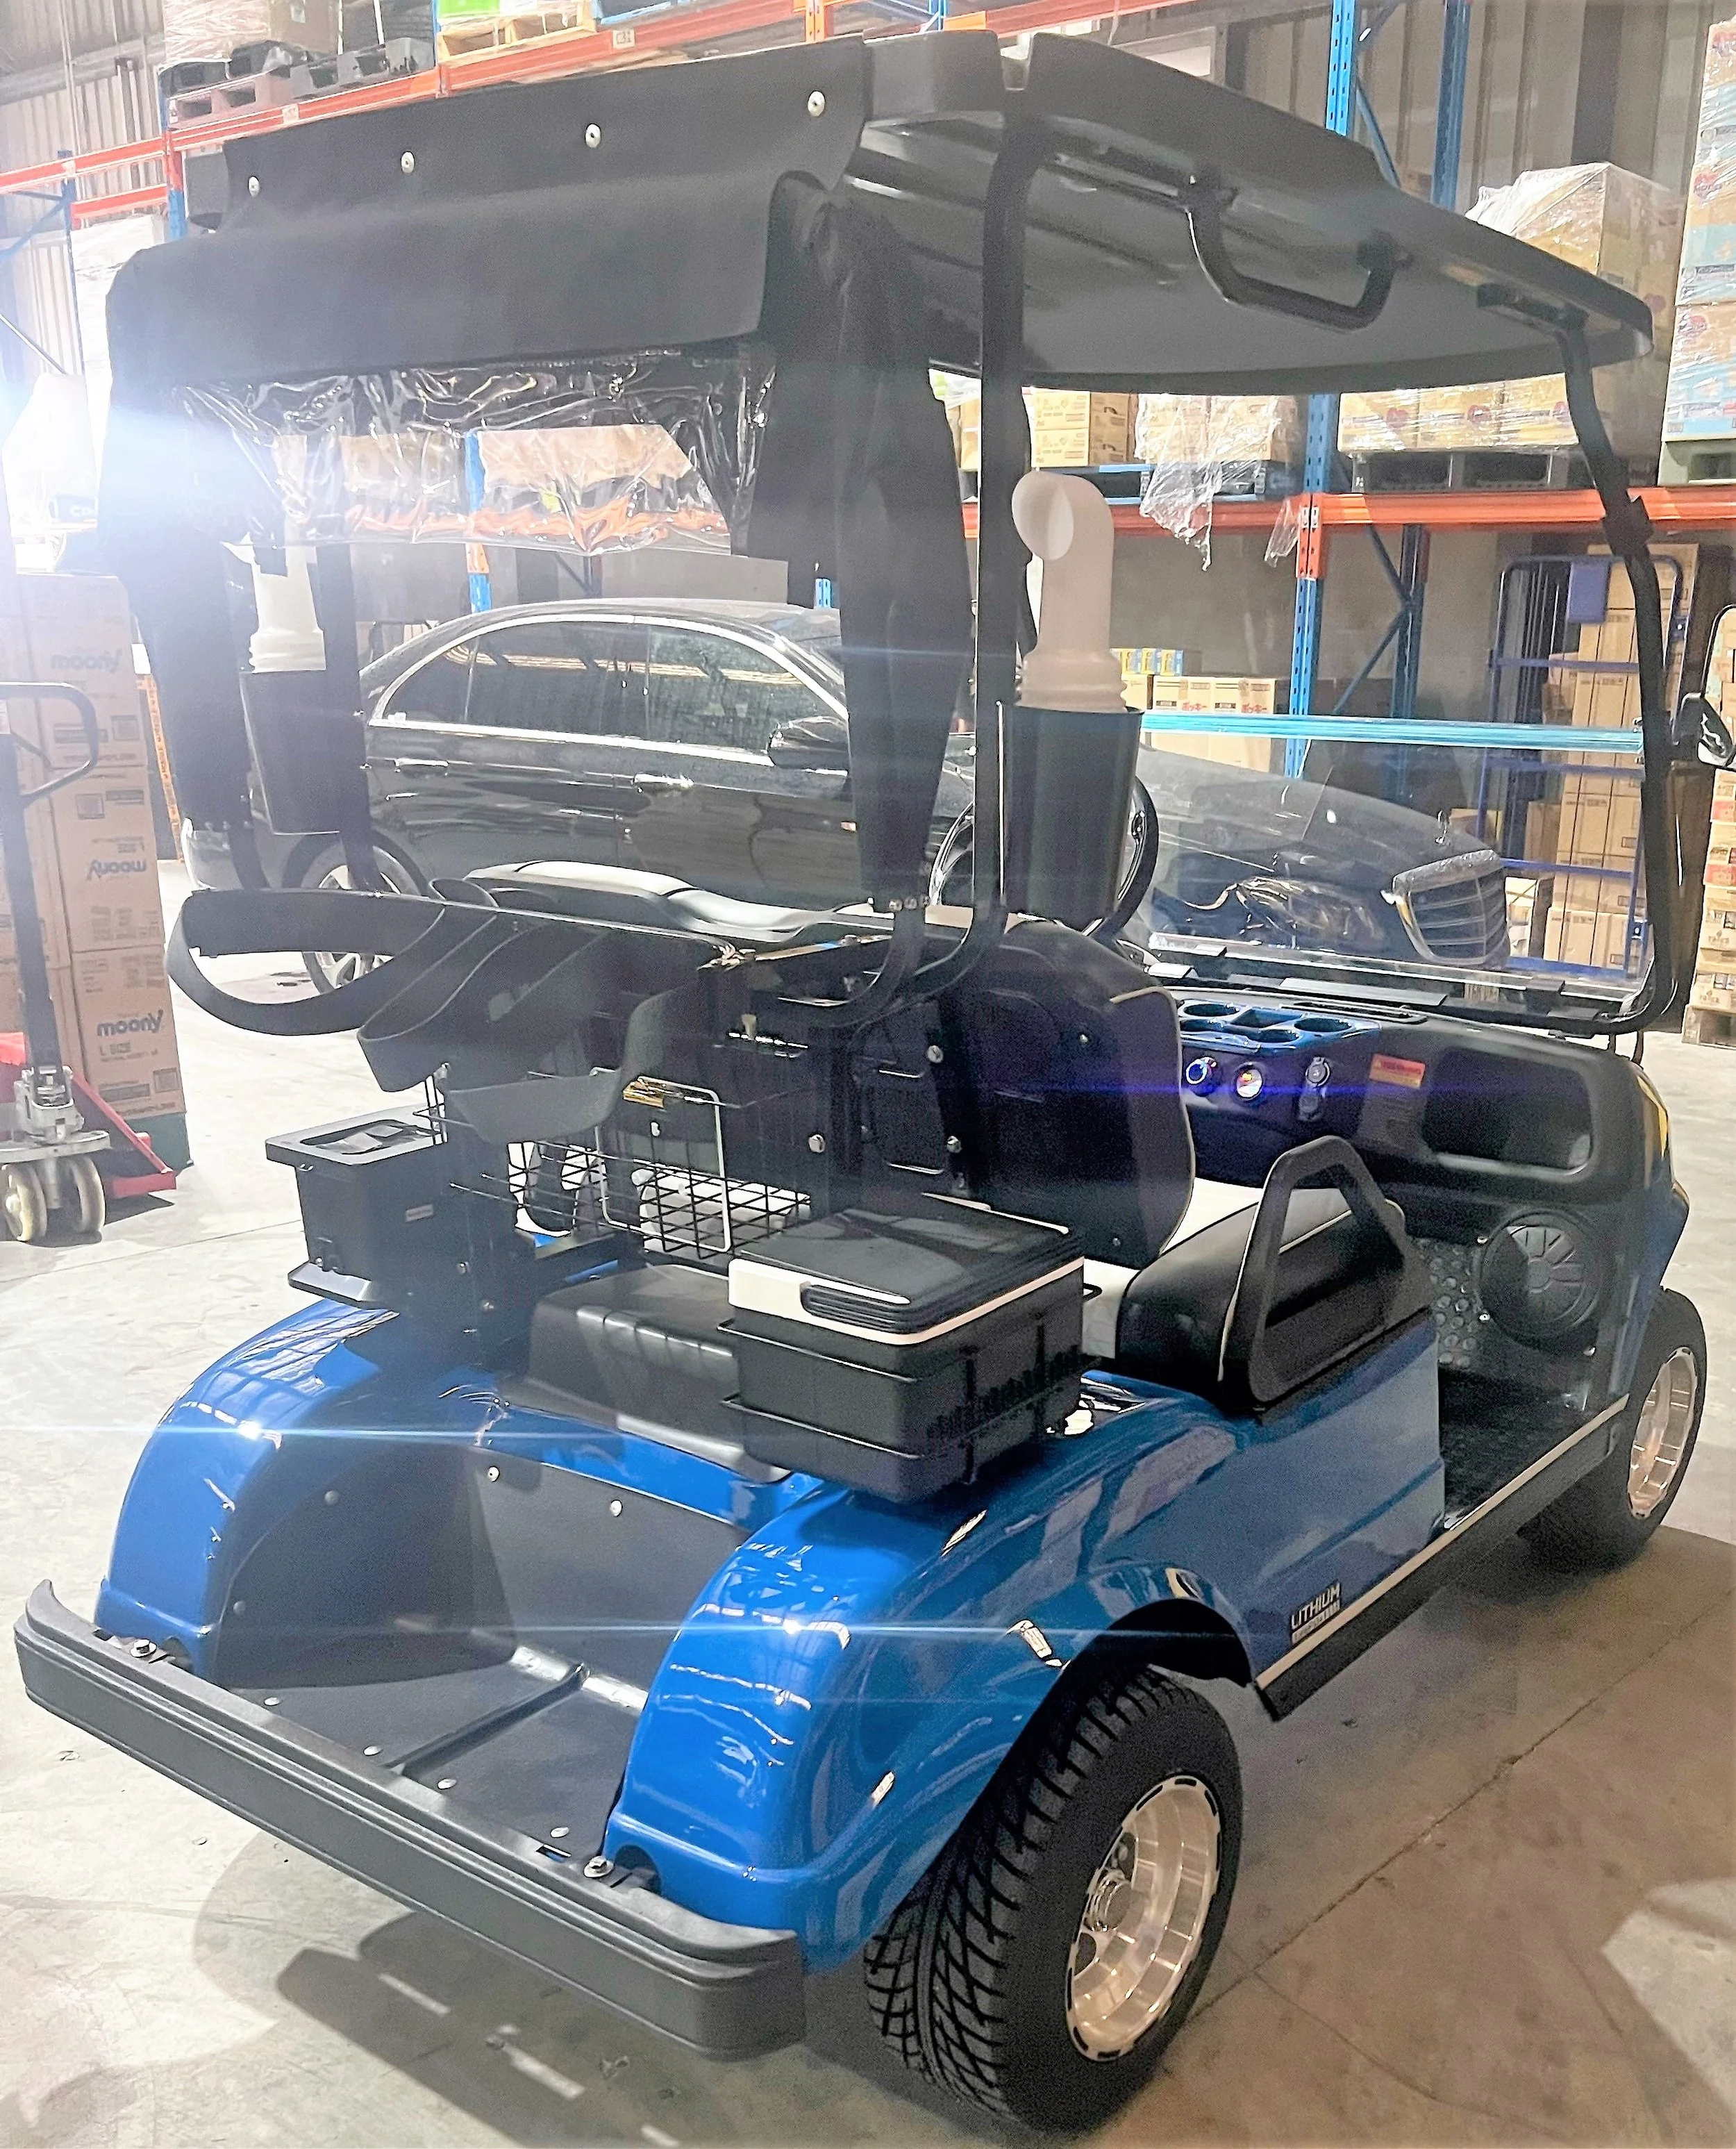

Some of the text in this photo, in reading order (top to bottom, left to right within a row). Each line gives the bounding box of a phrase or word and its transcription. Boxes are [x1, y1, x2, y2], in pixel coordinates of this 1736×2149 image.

[50, 649, 123, 674] moony
[86, 859, 147, 881] moony
[97, 1009, 164, 1036] moony
[1292, 1582, 1340, 1630] LITHIUM
